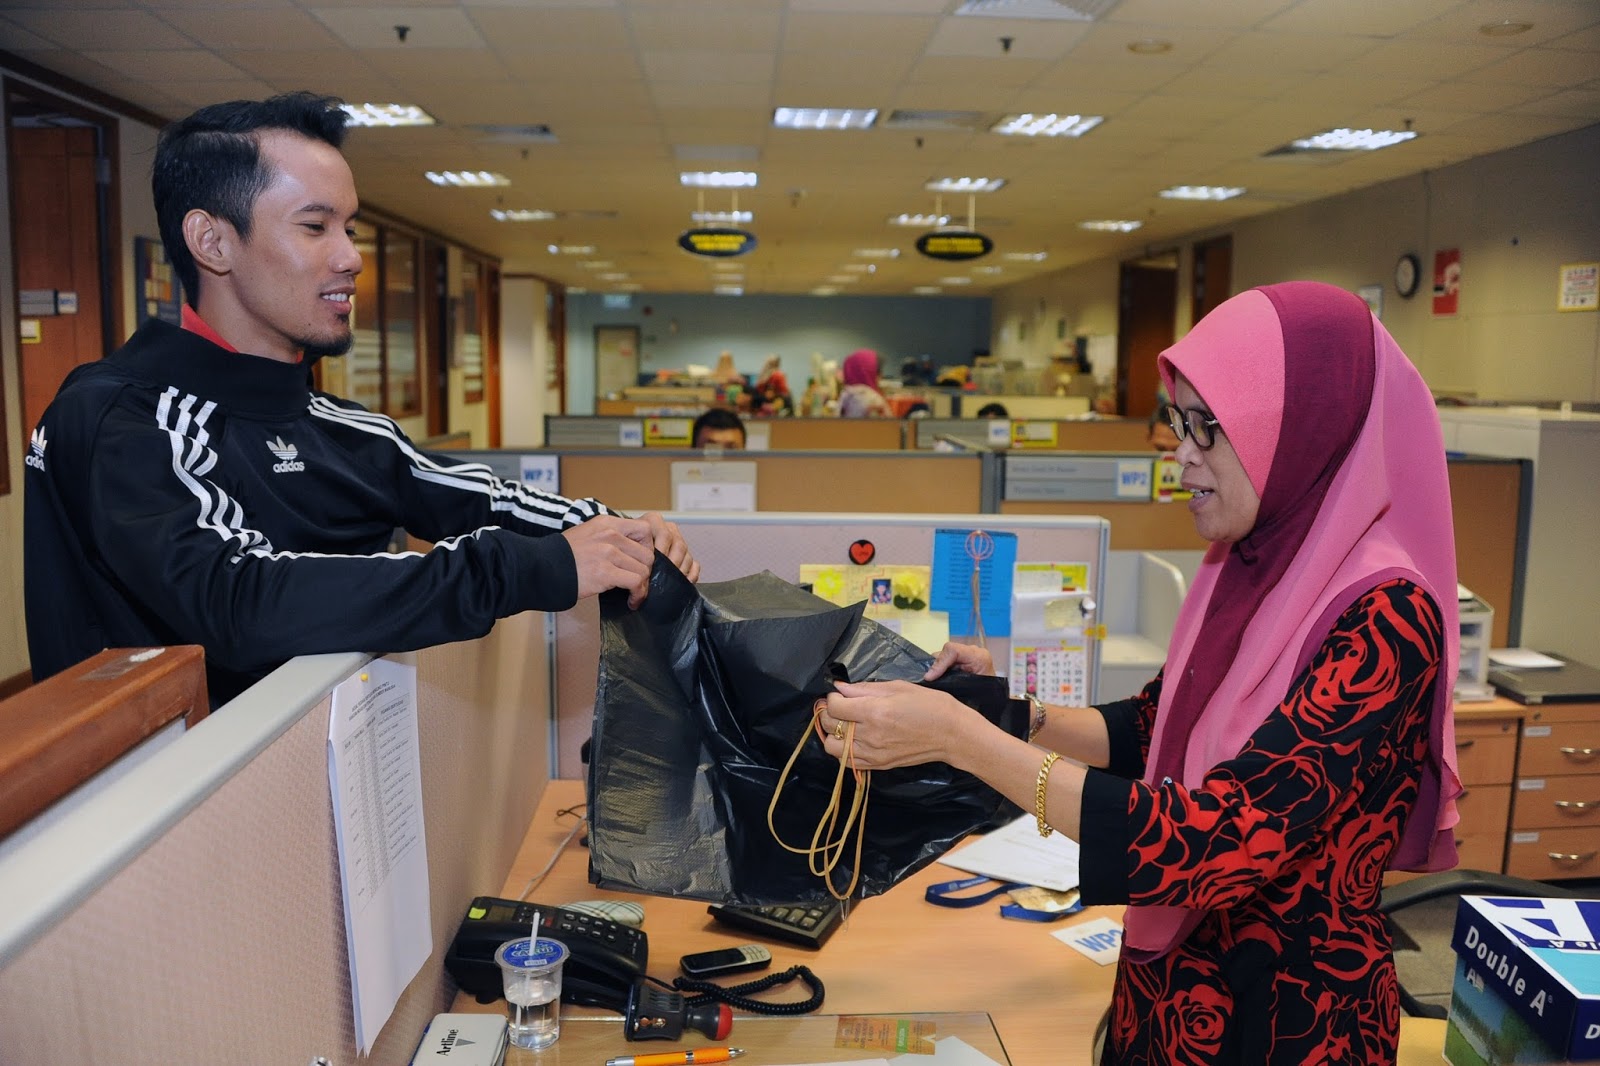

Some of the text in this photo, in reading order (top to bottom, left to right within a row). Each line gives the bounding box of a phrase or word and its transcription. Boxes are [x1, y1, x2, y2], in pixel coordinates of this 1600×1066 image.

[273, 460, 305, 473] adidas
[524, 469, 542, 481] WP
[1121, 471, 1147, 486] WP2
[1464, 925, 1526, 996] Double
[436, 1029, 459, 1056] Artline
